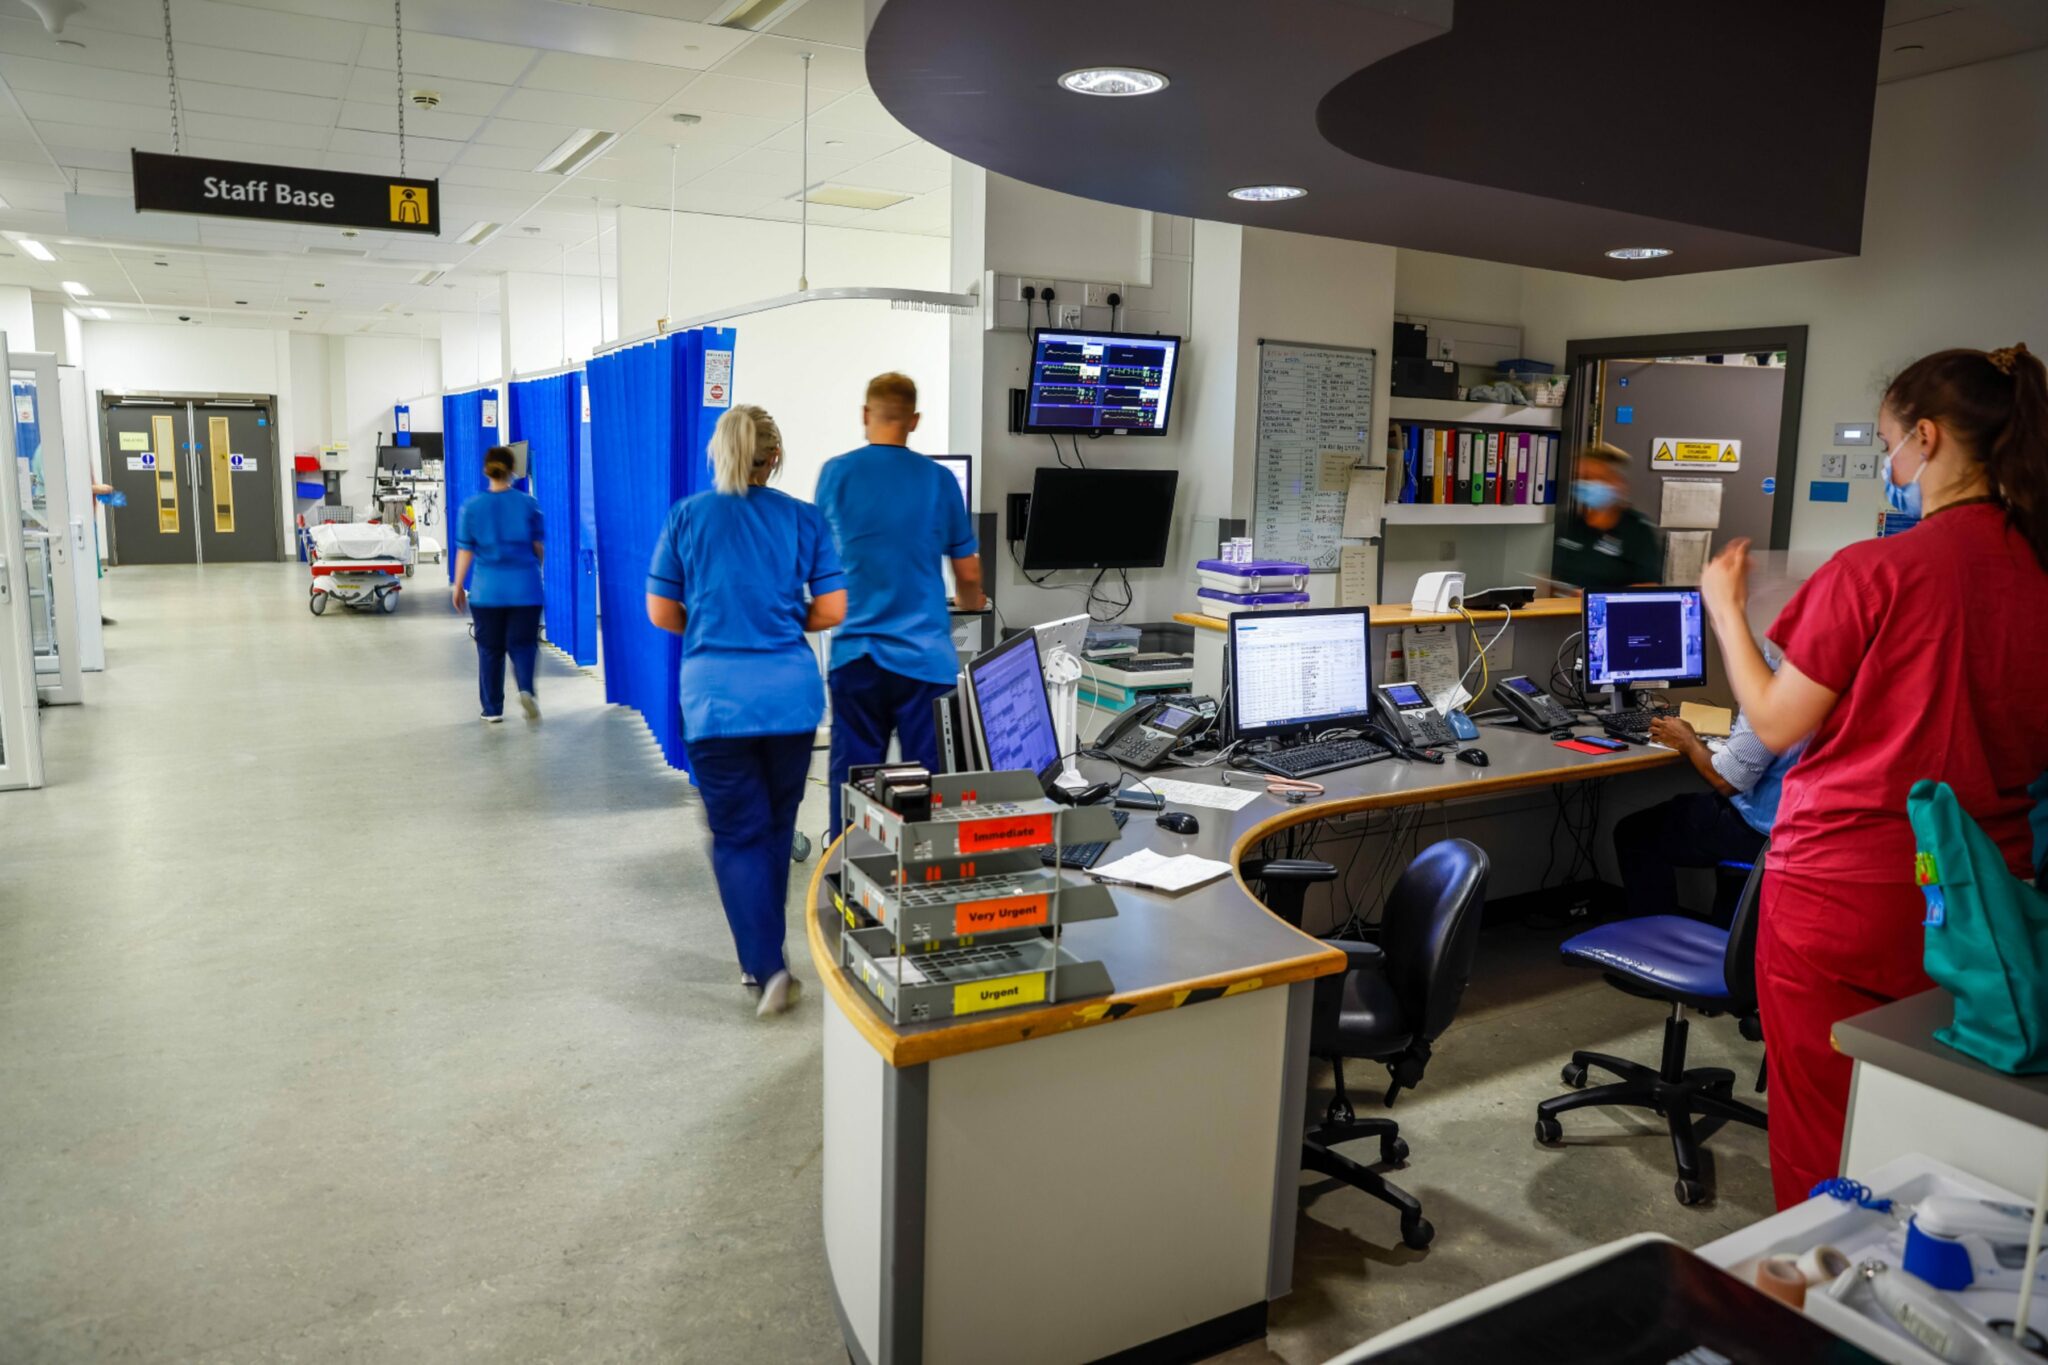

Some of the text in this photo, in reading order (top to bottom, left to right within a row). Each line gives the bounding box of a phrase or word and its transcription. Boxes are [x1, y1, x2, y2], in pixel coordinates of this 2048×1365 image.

[203, 176, 336, 209] Staff Base
[974, 826, 1035, 843] Immediate
[969, 904, 1037, 923] Very Urgent
[980, 985, 1019, 1001] Urgent
